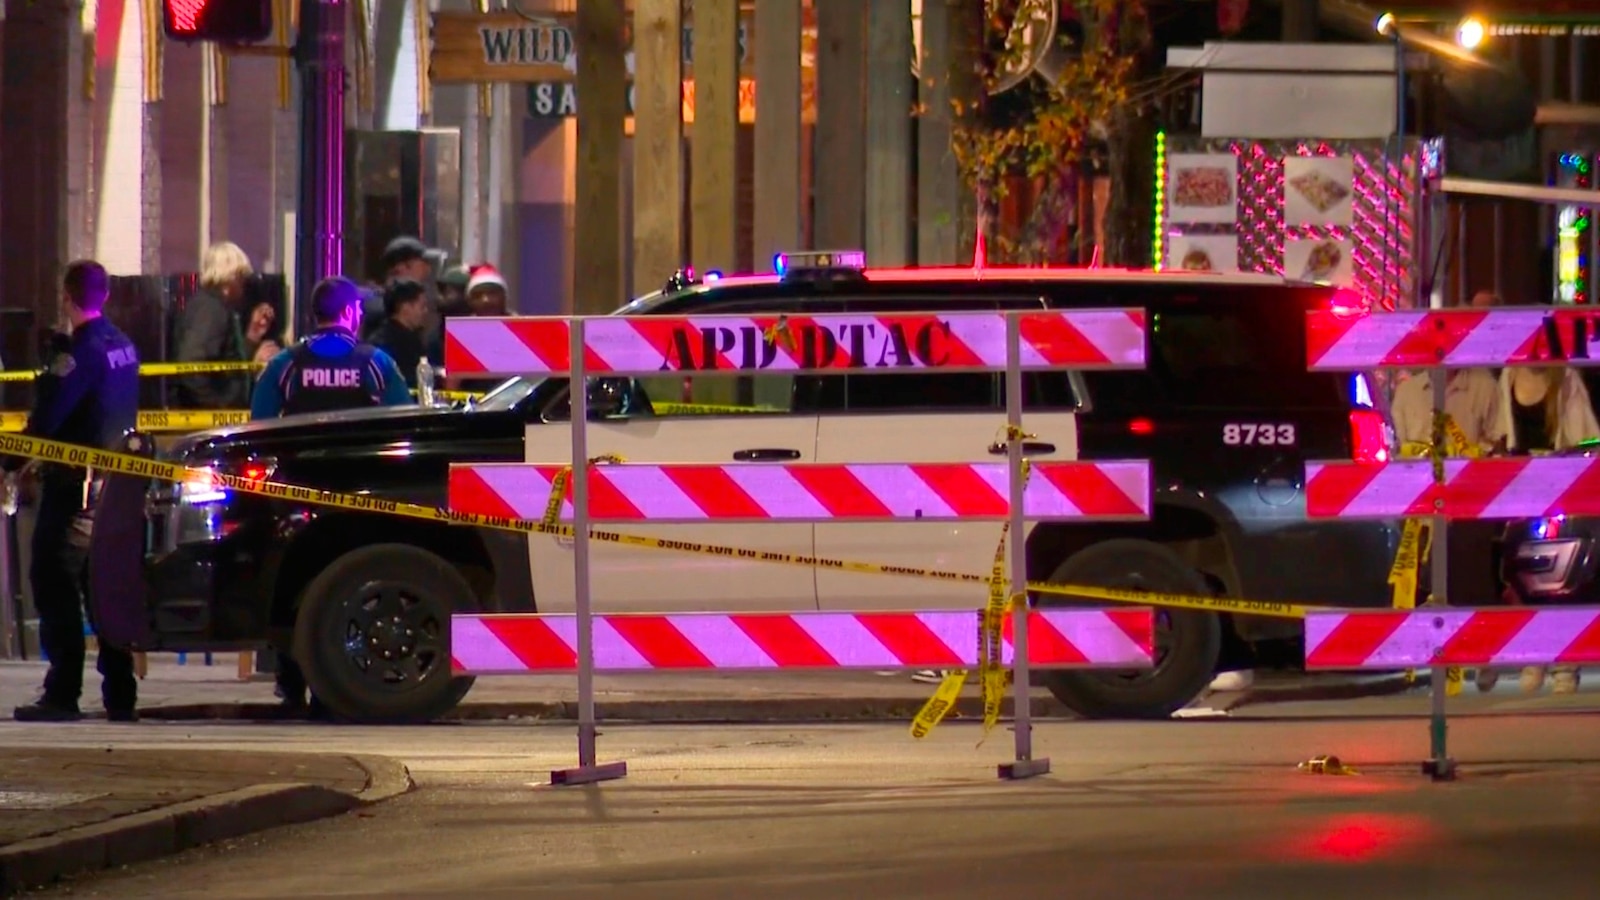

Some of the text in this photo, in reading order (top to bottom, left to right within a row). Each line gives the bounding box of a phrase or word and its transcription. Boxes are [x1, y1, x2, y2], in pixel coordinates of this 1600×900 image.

[481, 26, 573, 64] WILD
[659, 320, 950, 371] APD DTAC
[302, 368, 360, 387] POLICE
[140, 413, 169, 427] CROSS
[212, 413, 244, 427] POLICE
[1222, 424, 1296, 445] 8733
[38, 443, 65, 460] NOT
[69, 450, 88, 463] DO
[93, 453, 122, 468] LINE
[126, 459, 174, 478] POLICE
